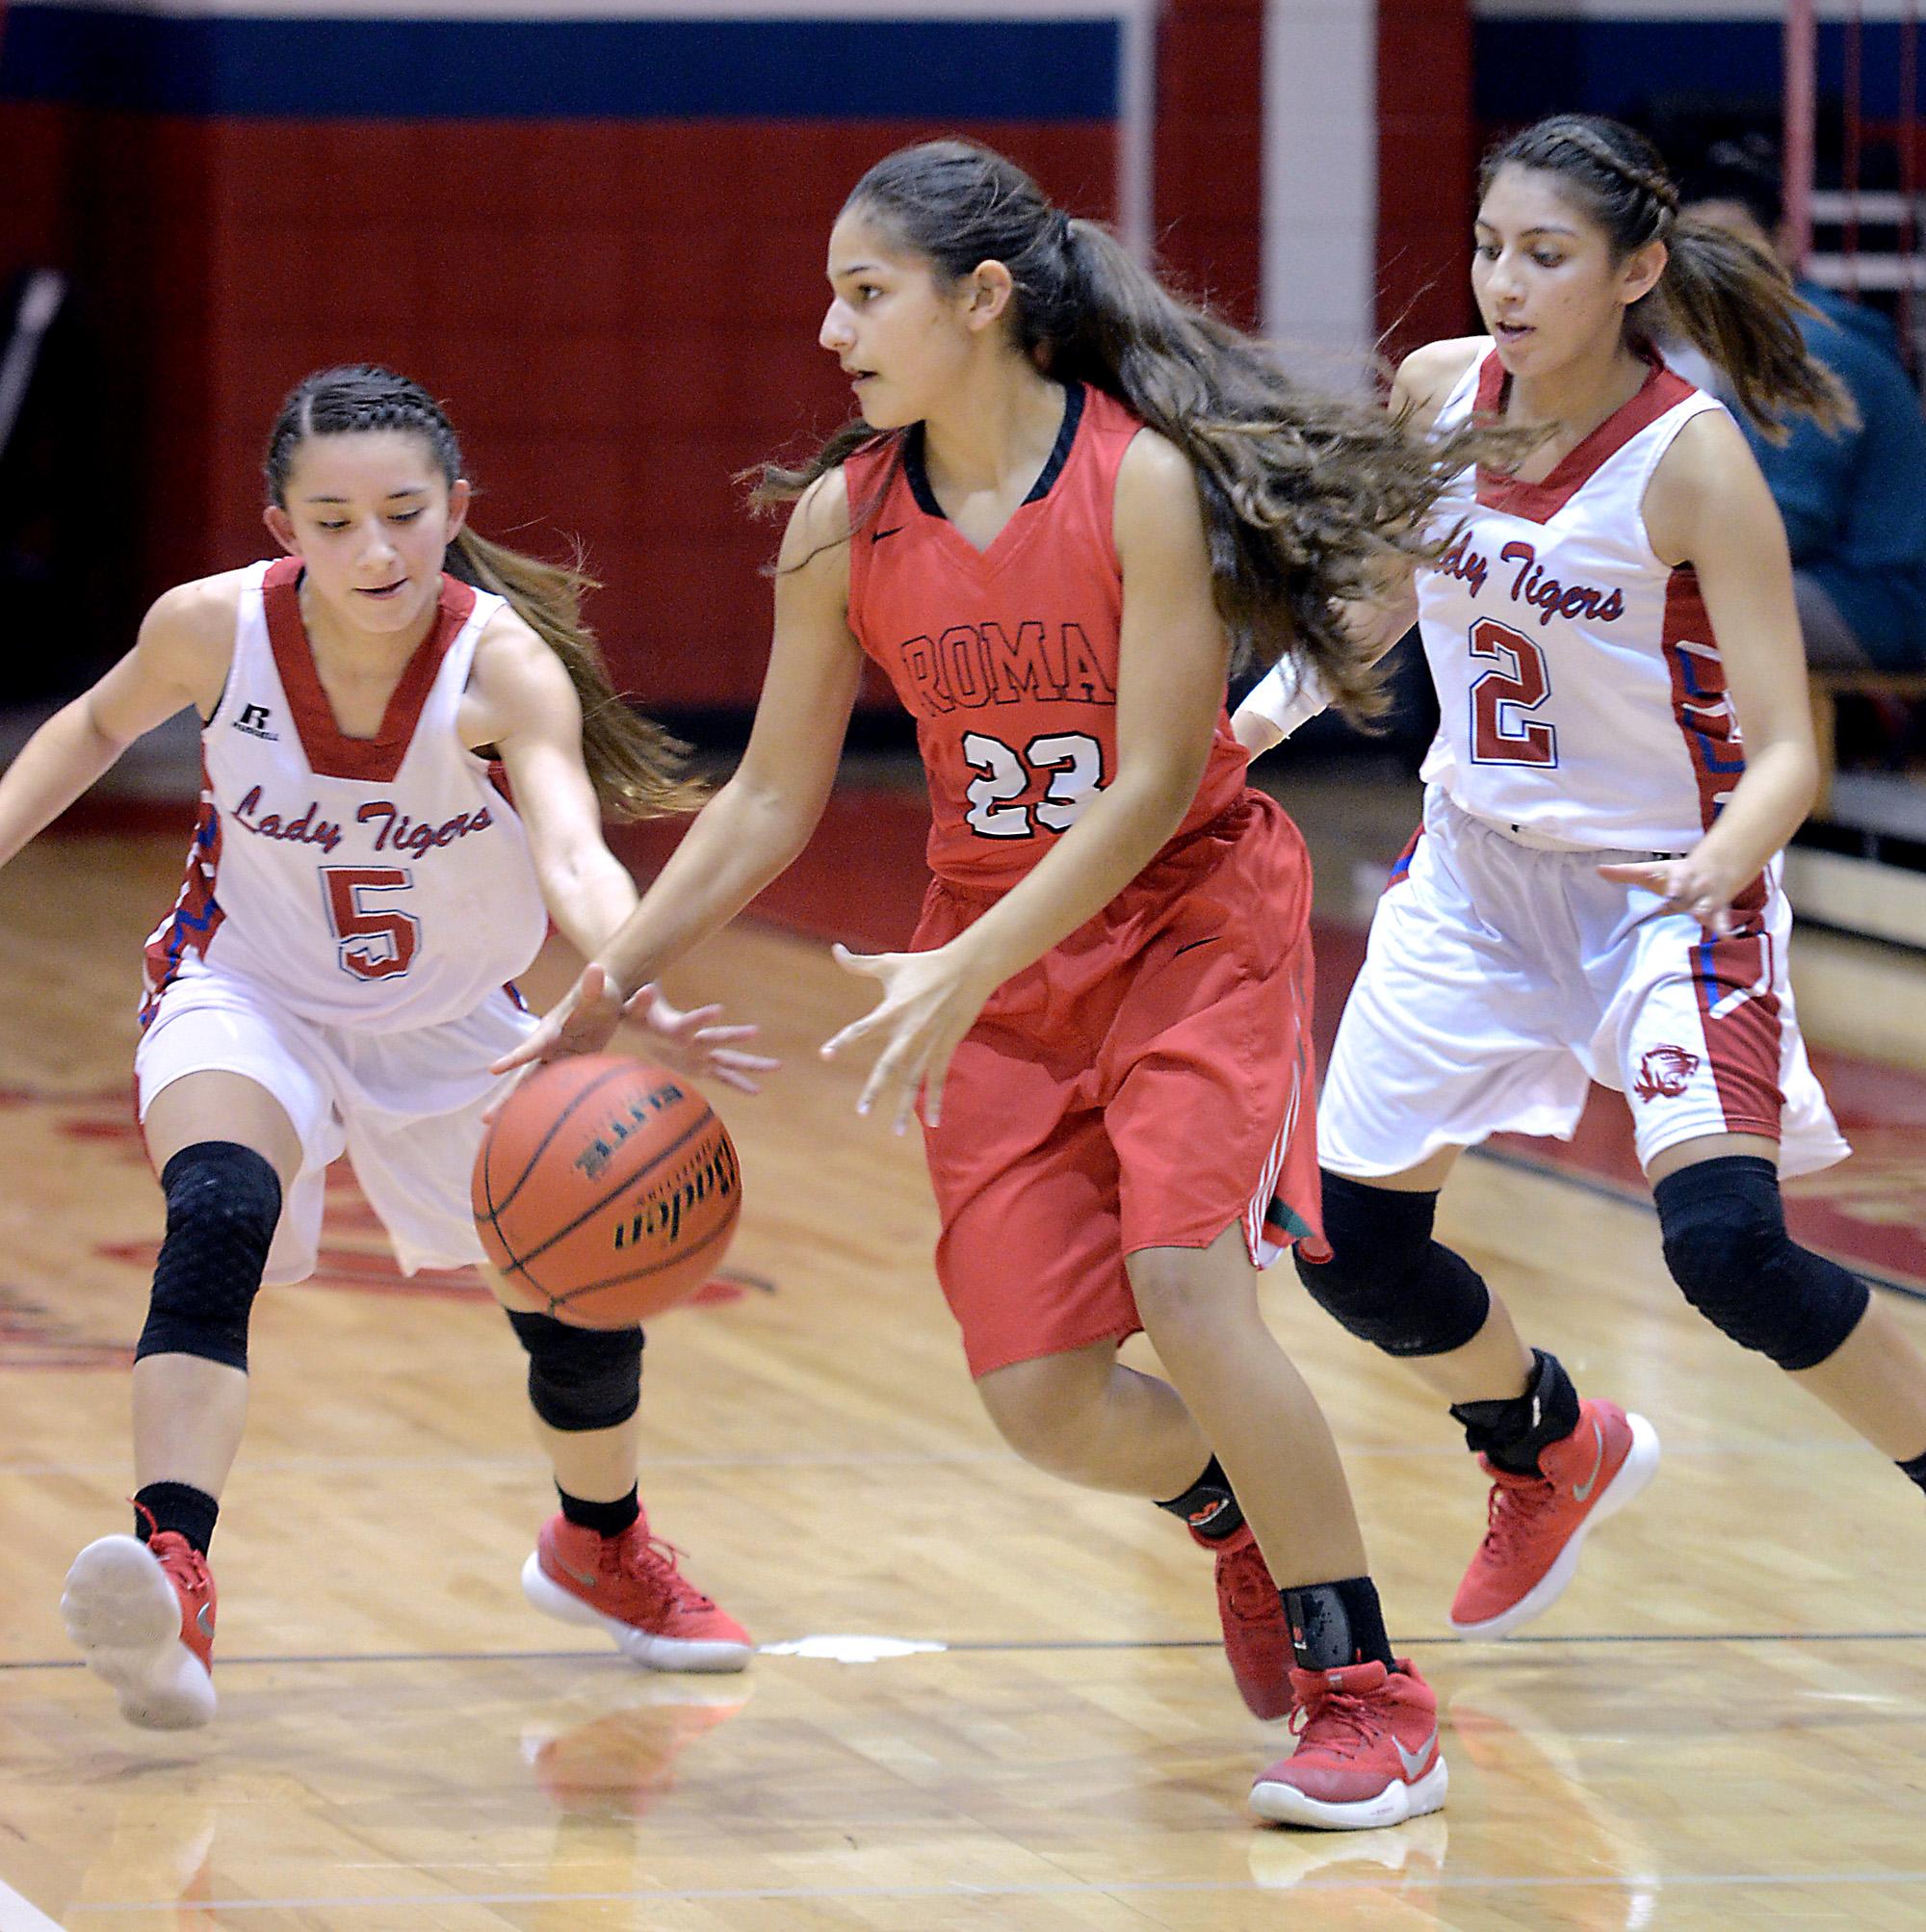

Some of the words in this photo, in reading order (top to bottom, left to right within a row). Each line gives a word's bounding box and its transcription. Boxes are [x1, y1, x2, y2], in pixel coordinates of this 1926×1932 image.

[1434, 531, 1489, 598] dy
[1500, 540, 1625, 626] Tigers
[900, 621, 1117, 717] ROMA
[1469, 615, 1558, 770] 2
[229, 784, 343, 853] Lady
[356, 800, 494, 860] Tigers
[962, 730, 1106, 840] 23
[317, 865, 422, 981] 5
